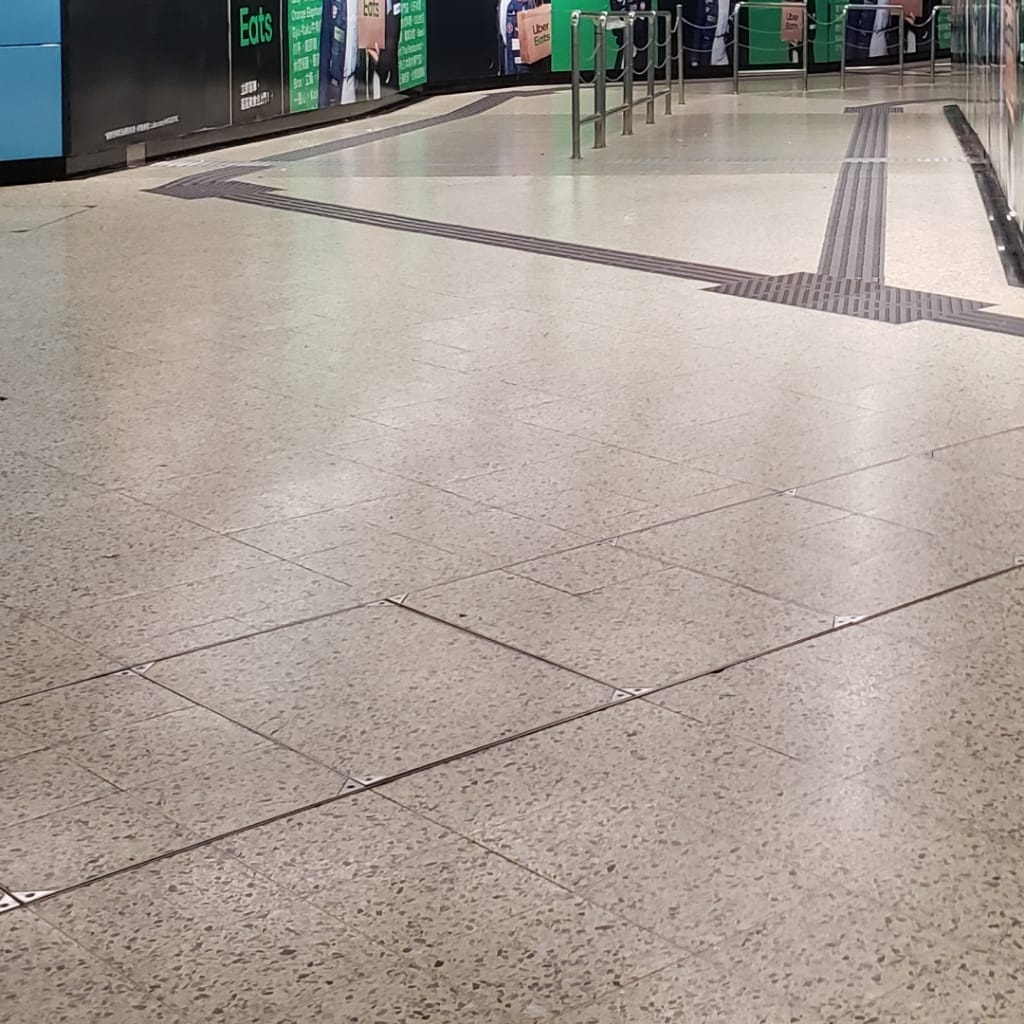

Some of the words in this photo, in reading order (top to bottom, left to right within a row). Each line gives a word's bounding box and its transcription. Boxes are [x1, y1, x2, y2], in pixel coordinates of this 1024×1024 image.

[239, 7, 273, 47] Eats
[532, 23, 549, 35] Uber
[534, 33, 551, 46] Eats
